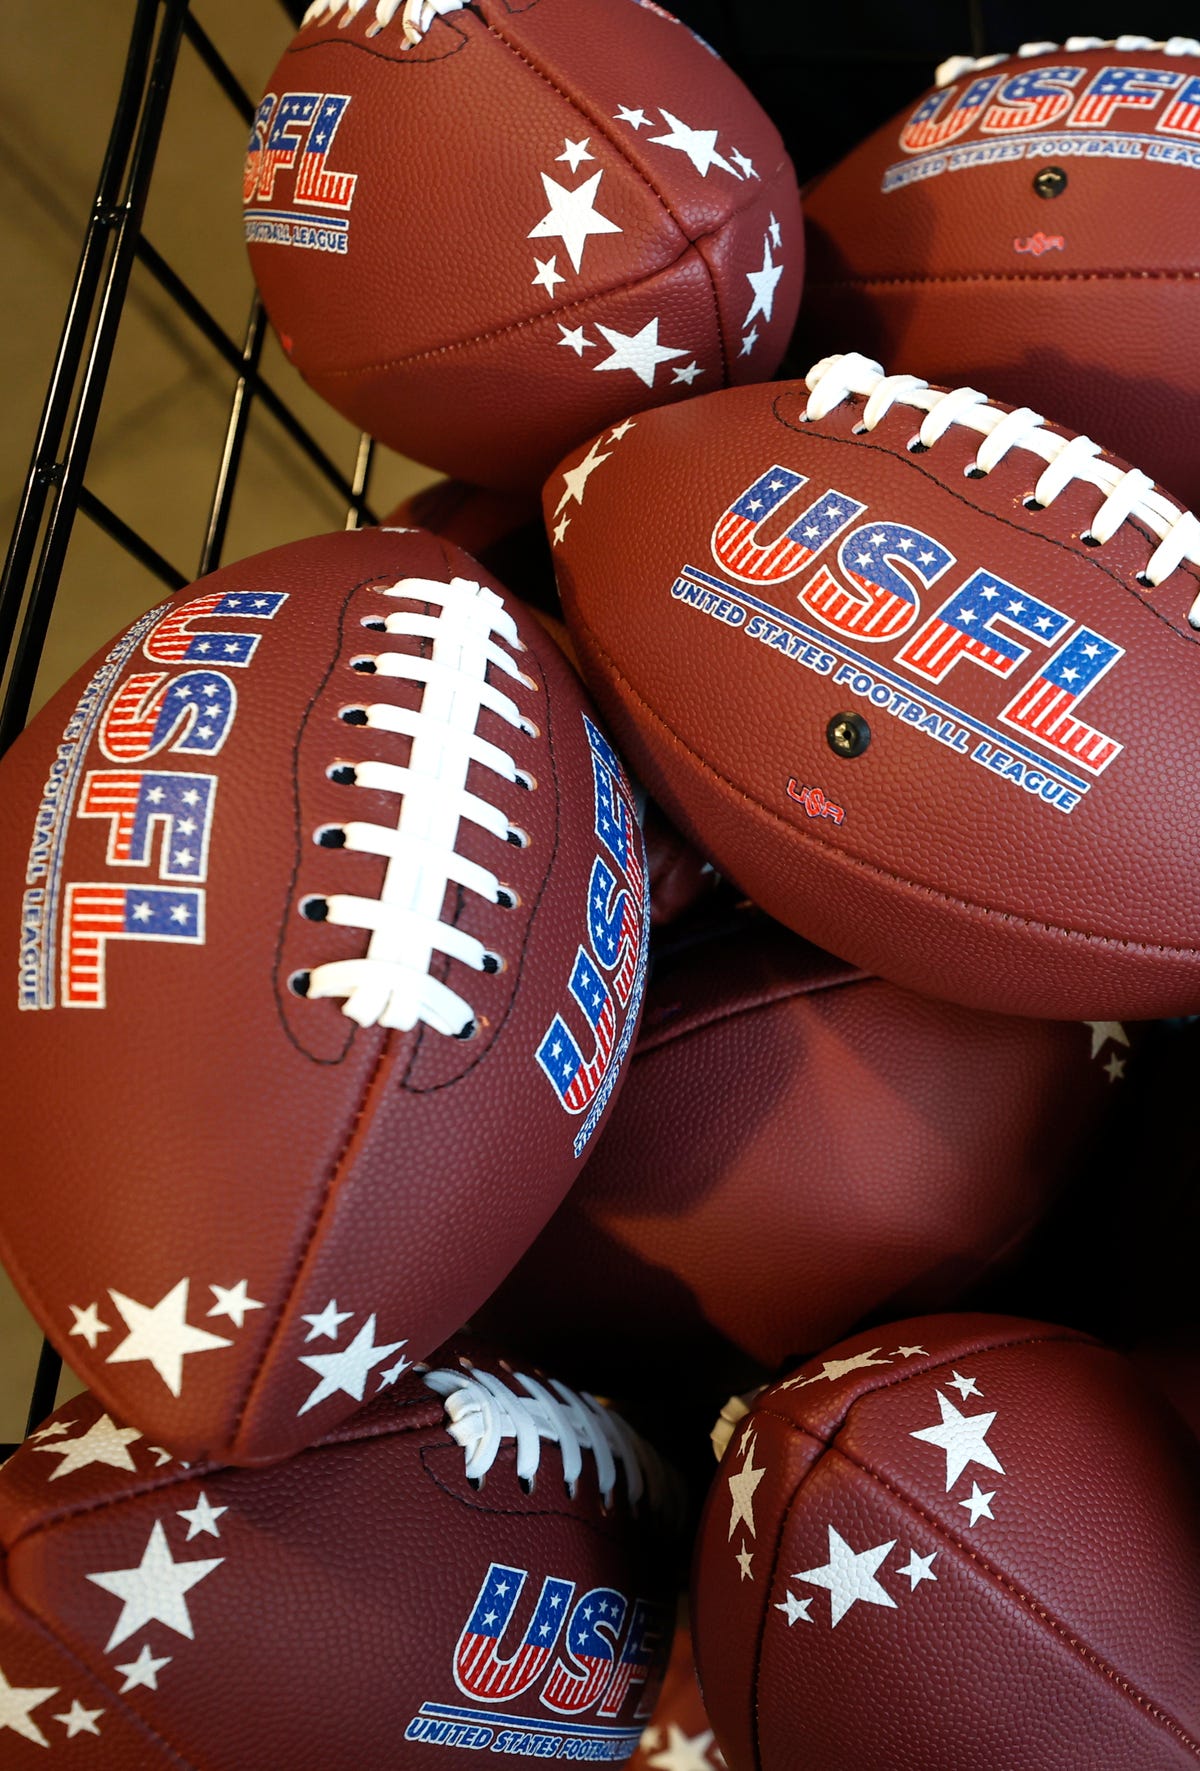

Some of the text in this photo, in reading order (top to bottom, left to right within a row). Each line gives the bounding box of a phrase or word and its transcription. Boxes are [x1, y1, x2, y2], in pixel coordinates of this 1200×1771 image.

[243, 92, 358, 211] SFL
[948, 142, 1026, 172] STATES
[1026, 137, 1143, 160] FOOTBALL
[292, 226, 349, 254] LEAGUE
[710, 463, 1127, 778] USFL
[670, 577, 1083, 816] UNITED STATES FOOTBALL LEAGUE
[26, 743, 76, 885] FOOTBALL
[61, 591, 290, 1009] USFL
[786, 776, 847, 826] USA
[18, 888, 46, 1011] LEAGUE
[404, 1716, 494, 1750] UNITED
[490, 1730, 563, 1759] STATES
